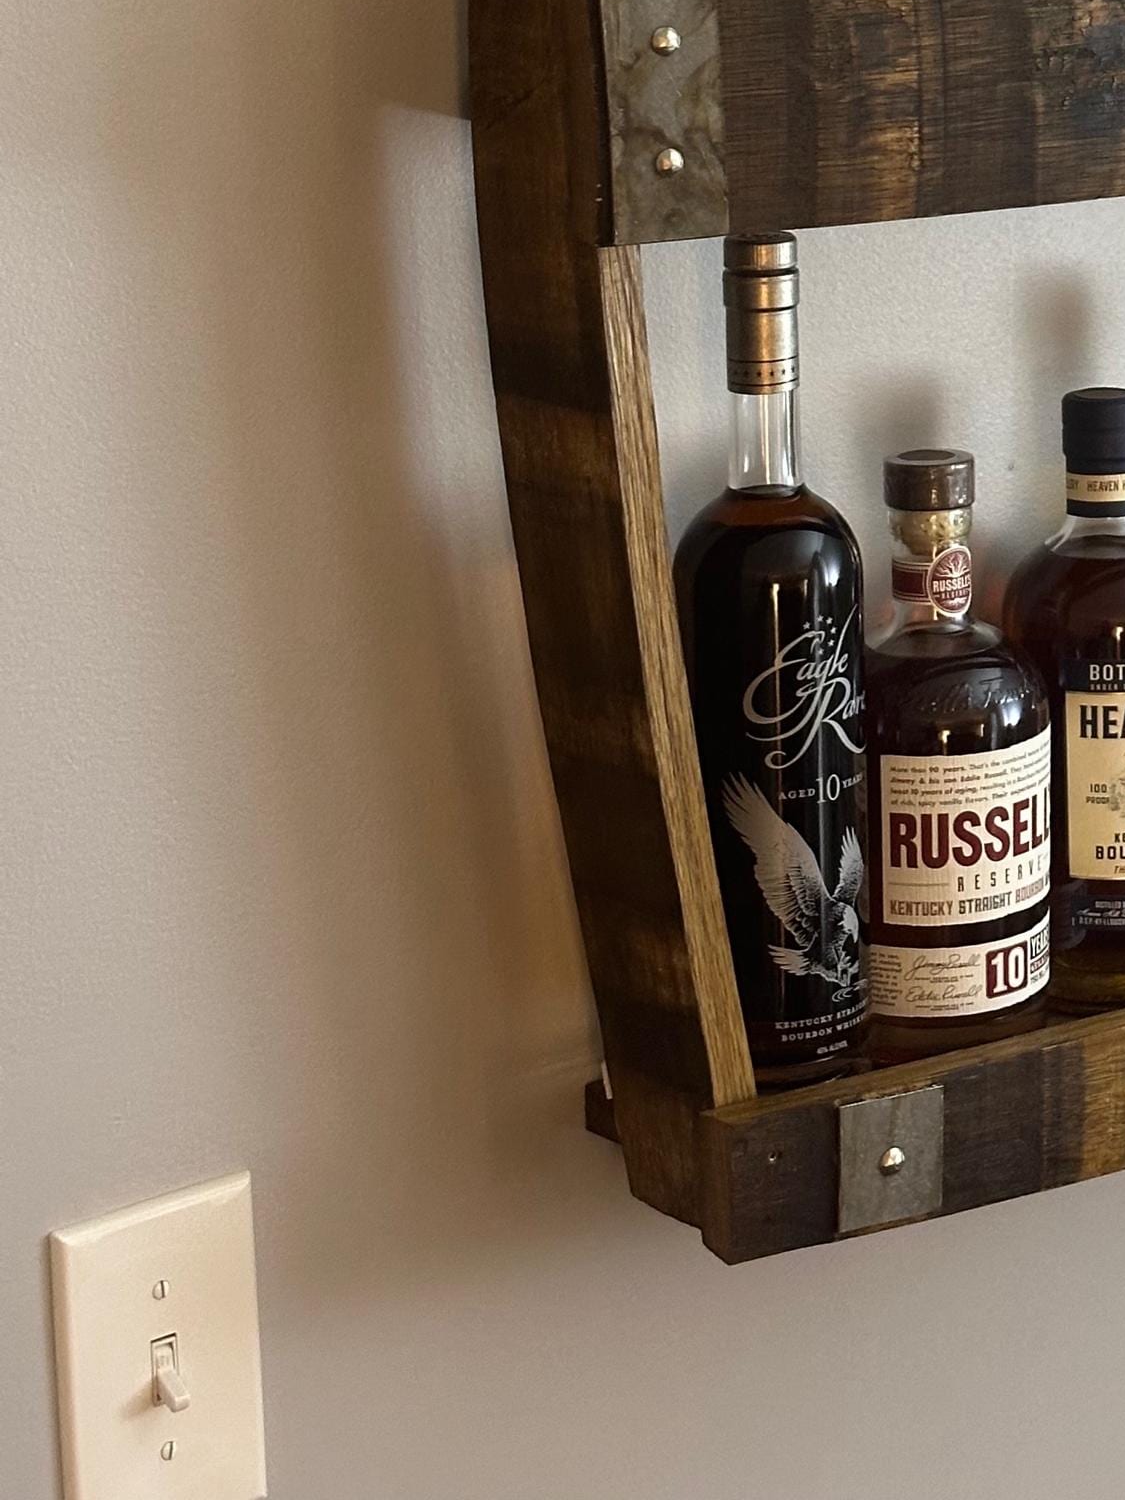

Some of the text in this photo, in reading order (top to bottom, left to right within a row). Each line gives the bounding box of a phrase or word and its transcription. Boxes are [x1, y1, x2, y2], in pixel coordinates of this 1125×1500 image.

[1087, 481, 1119, 492] HEAVEN
[742, 604, 857, 742] Eagle
[928, 765, 940, 774] 90
[778, 773, 841, 804] AGED 10
[1090, 783, 1107, 793] 100
[957, 852, 1042, 893] RESERVE
[890, 900, 954, 917] KENTUCKY
[958, 891, 1012, 915] STRAIGHT
[991, 946, 1025, 994] 10
[775, 1013, 834, 1030] KENTUCKY
[781, 1026, 833, 1042] BOURBON
